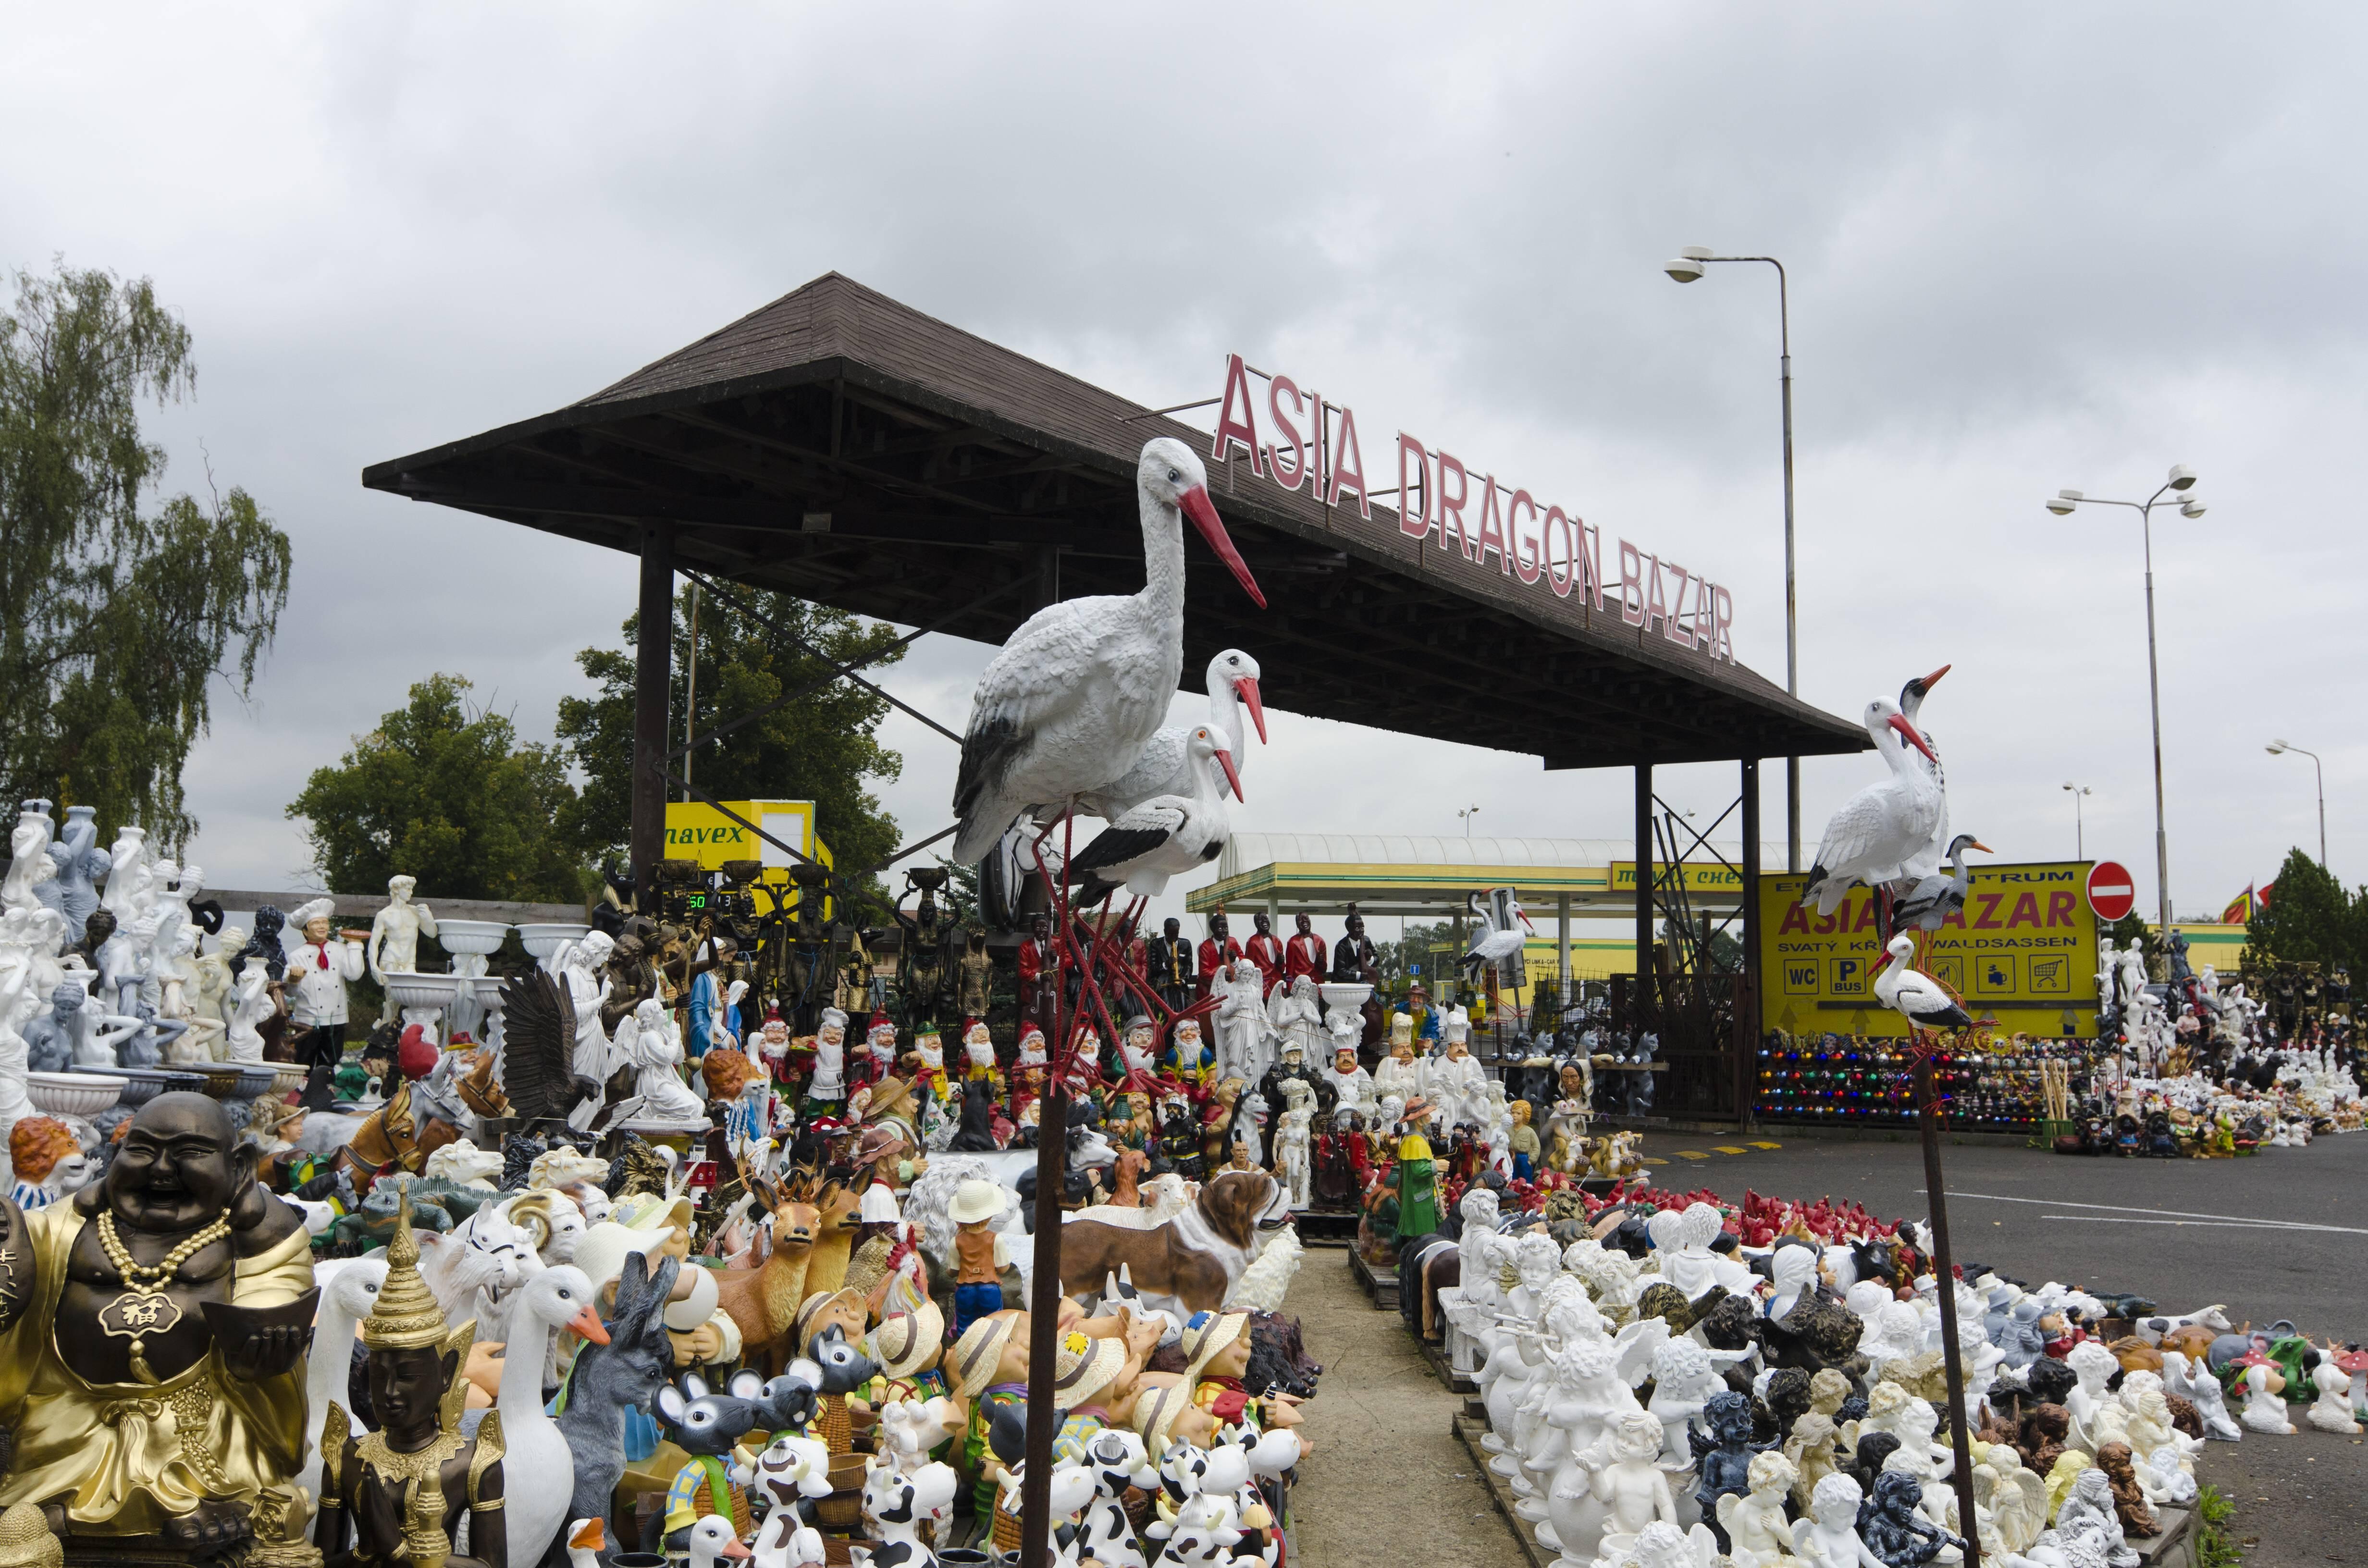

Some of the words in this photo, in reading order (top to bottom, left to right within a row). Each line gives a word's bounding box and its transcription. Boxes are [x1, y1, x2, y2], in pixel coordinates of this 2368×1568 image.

[1211, 350, 1371, 521] ASIA
[1398, 429, 1603, 612] DRAGON
[1619, 536, 1735, 666] BAZAR
[1779, 898, 1876, 935] ASIA
[1906, 891, 2077, 931] AZAR
[1778, 940, 1838, 952] SVATÝ
[1929, 937, 2077, 949] WALDSASSEN
[1789, 968, 1815, 985] WC
[1840, 961, 1857, 981] P
[1835, 982, 1862, 991] BUS
